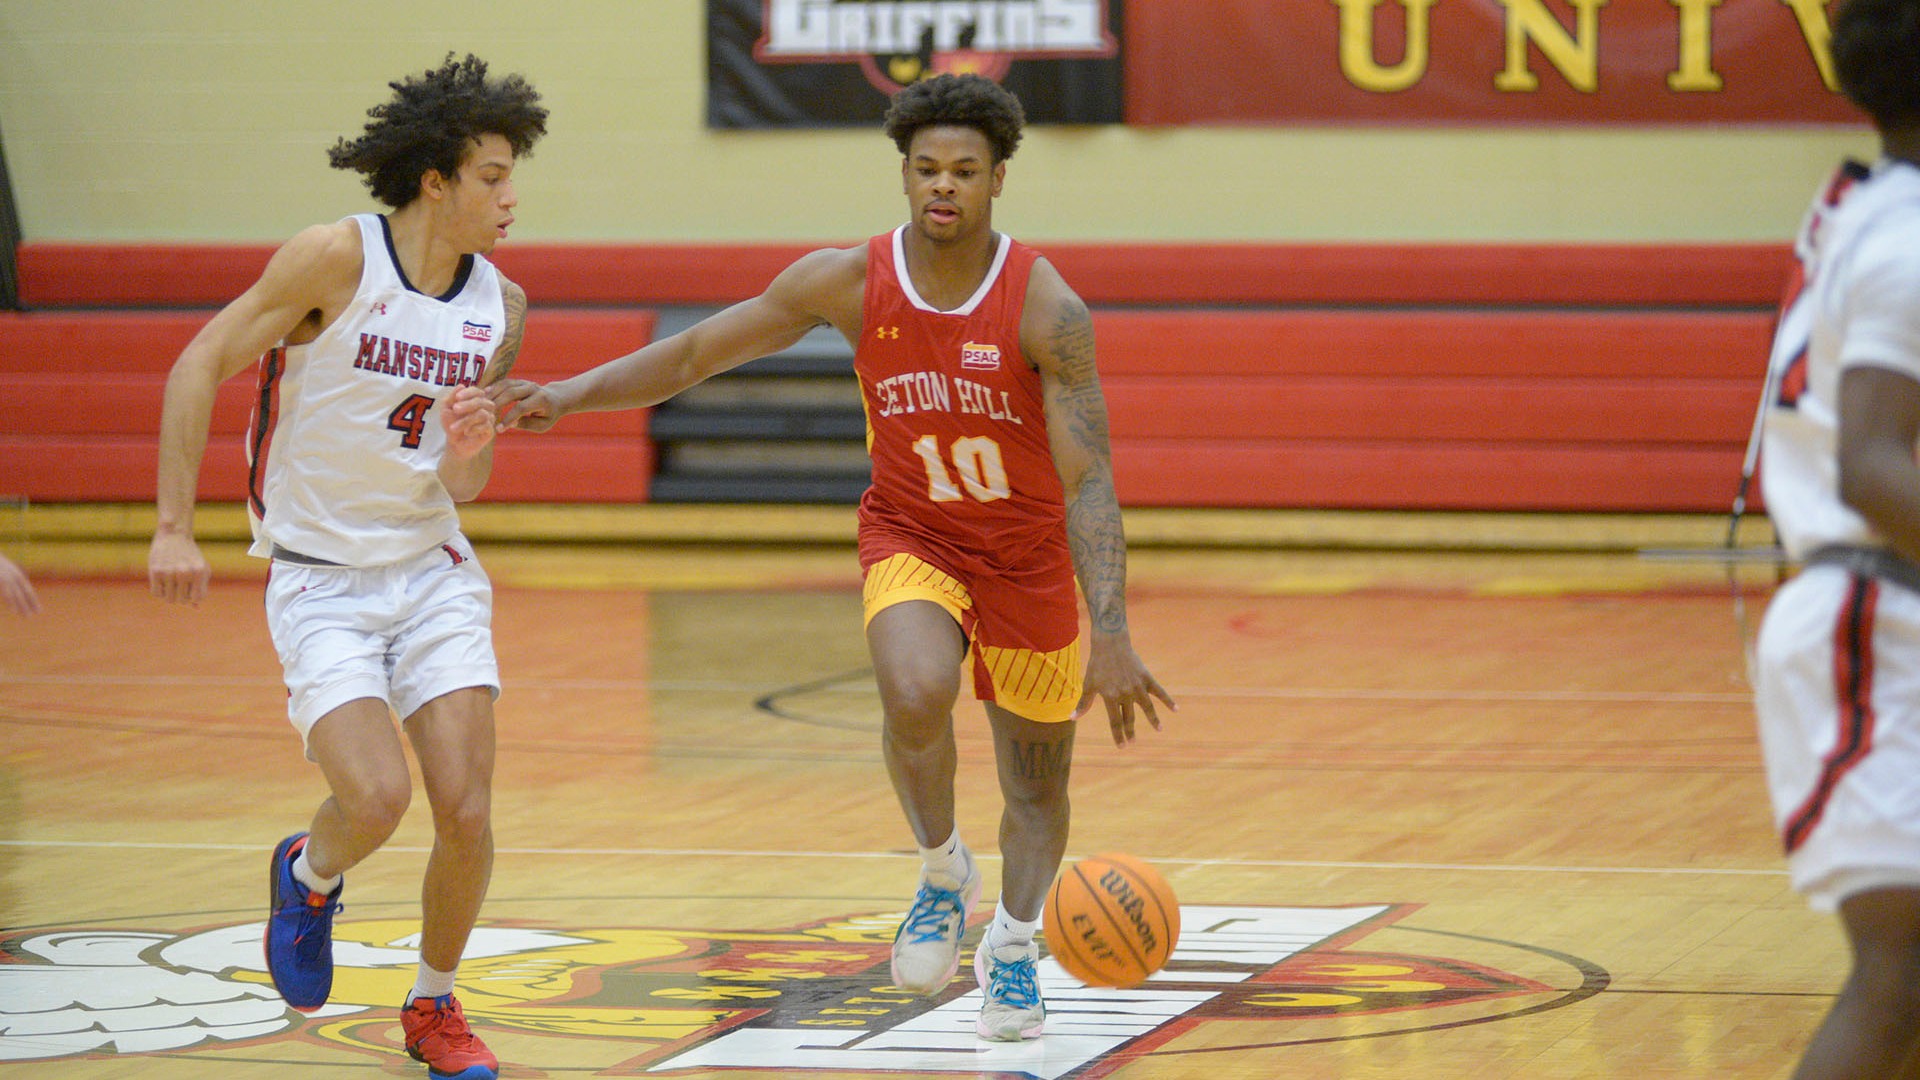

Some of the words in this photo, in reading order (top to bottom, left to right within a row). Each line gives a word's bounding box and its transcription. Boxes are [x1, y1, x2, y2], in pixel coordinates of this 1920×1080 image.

[463, 325, 492, 338] PSAC
[963, 350, 1000, 364] PSAC
[353, 333, 487, 388] MANSFIELD
[386, 393, 436, 450] 4
[876, 371, 951, 417] SETON
[954, 377, 1024, 425] HILL
[912, 434, 1013, 503] 10
[1099, 867, 1158, 955] Wilson
